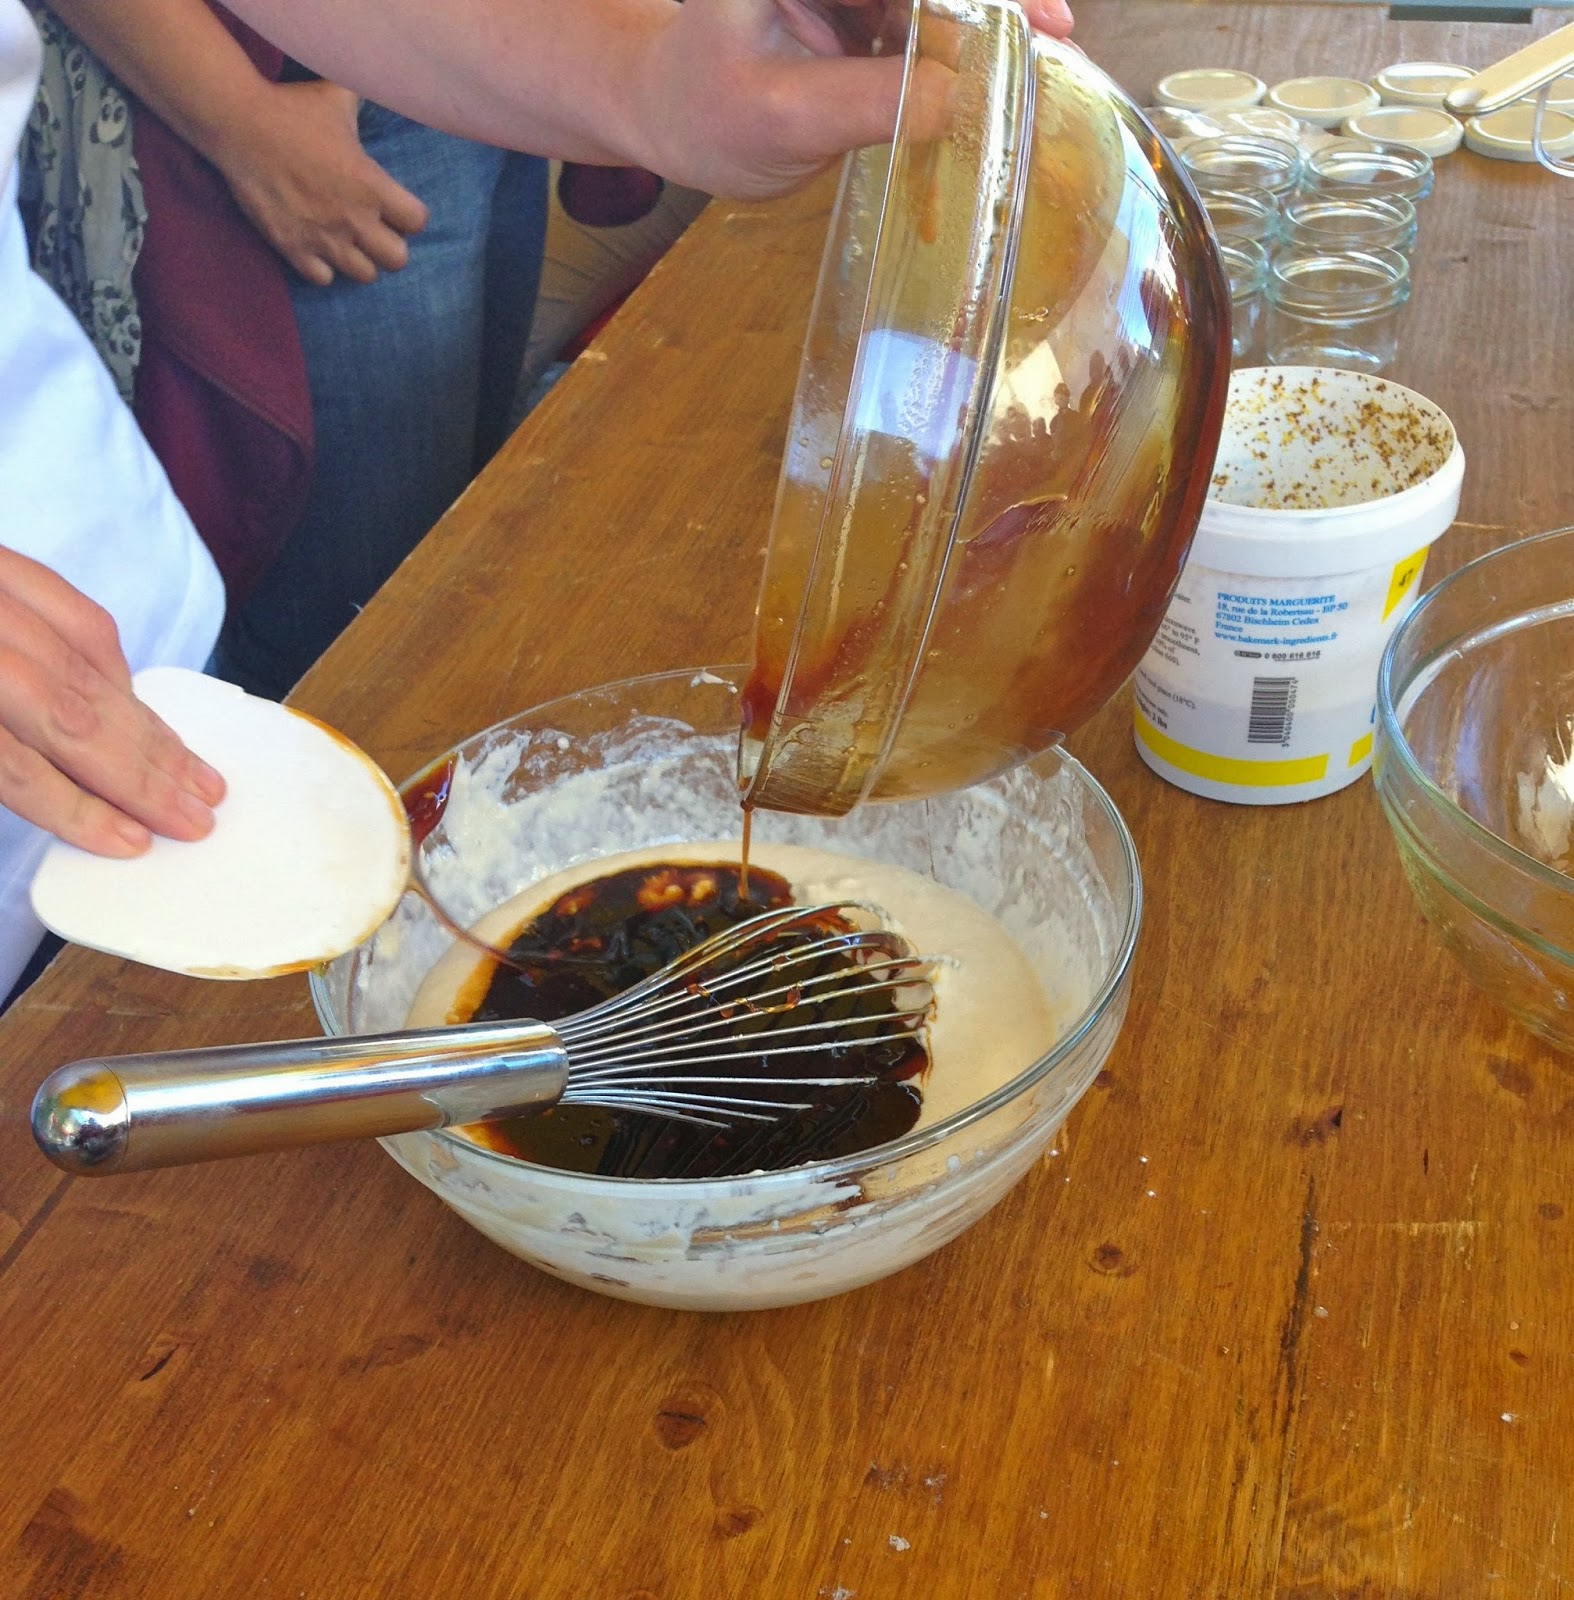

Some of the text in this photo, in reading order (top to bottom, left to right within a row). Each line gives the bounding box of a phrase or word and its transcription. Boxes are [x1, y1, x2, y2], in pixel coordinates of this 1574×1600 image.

[1217, 592, 1336, 606] PRODUITS MARGUERITE
[1232, 606, 1246, 614] rue
[1247, 606, 1258, 615] de
[1260, 607, 1268, 615] la
[1323, 603, 1336, 613] BP
[1216, 621, 1243, 633] France
[1244, 616, 1290, 626] Bischheim
[1292, 616, 1319, 626] Cedex
